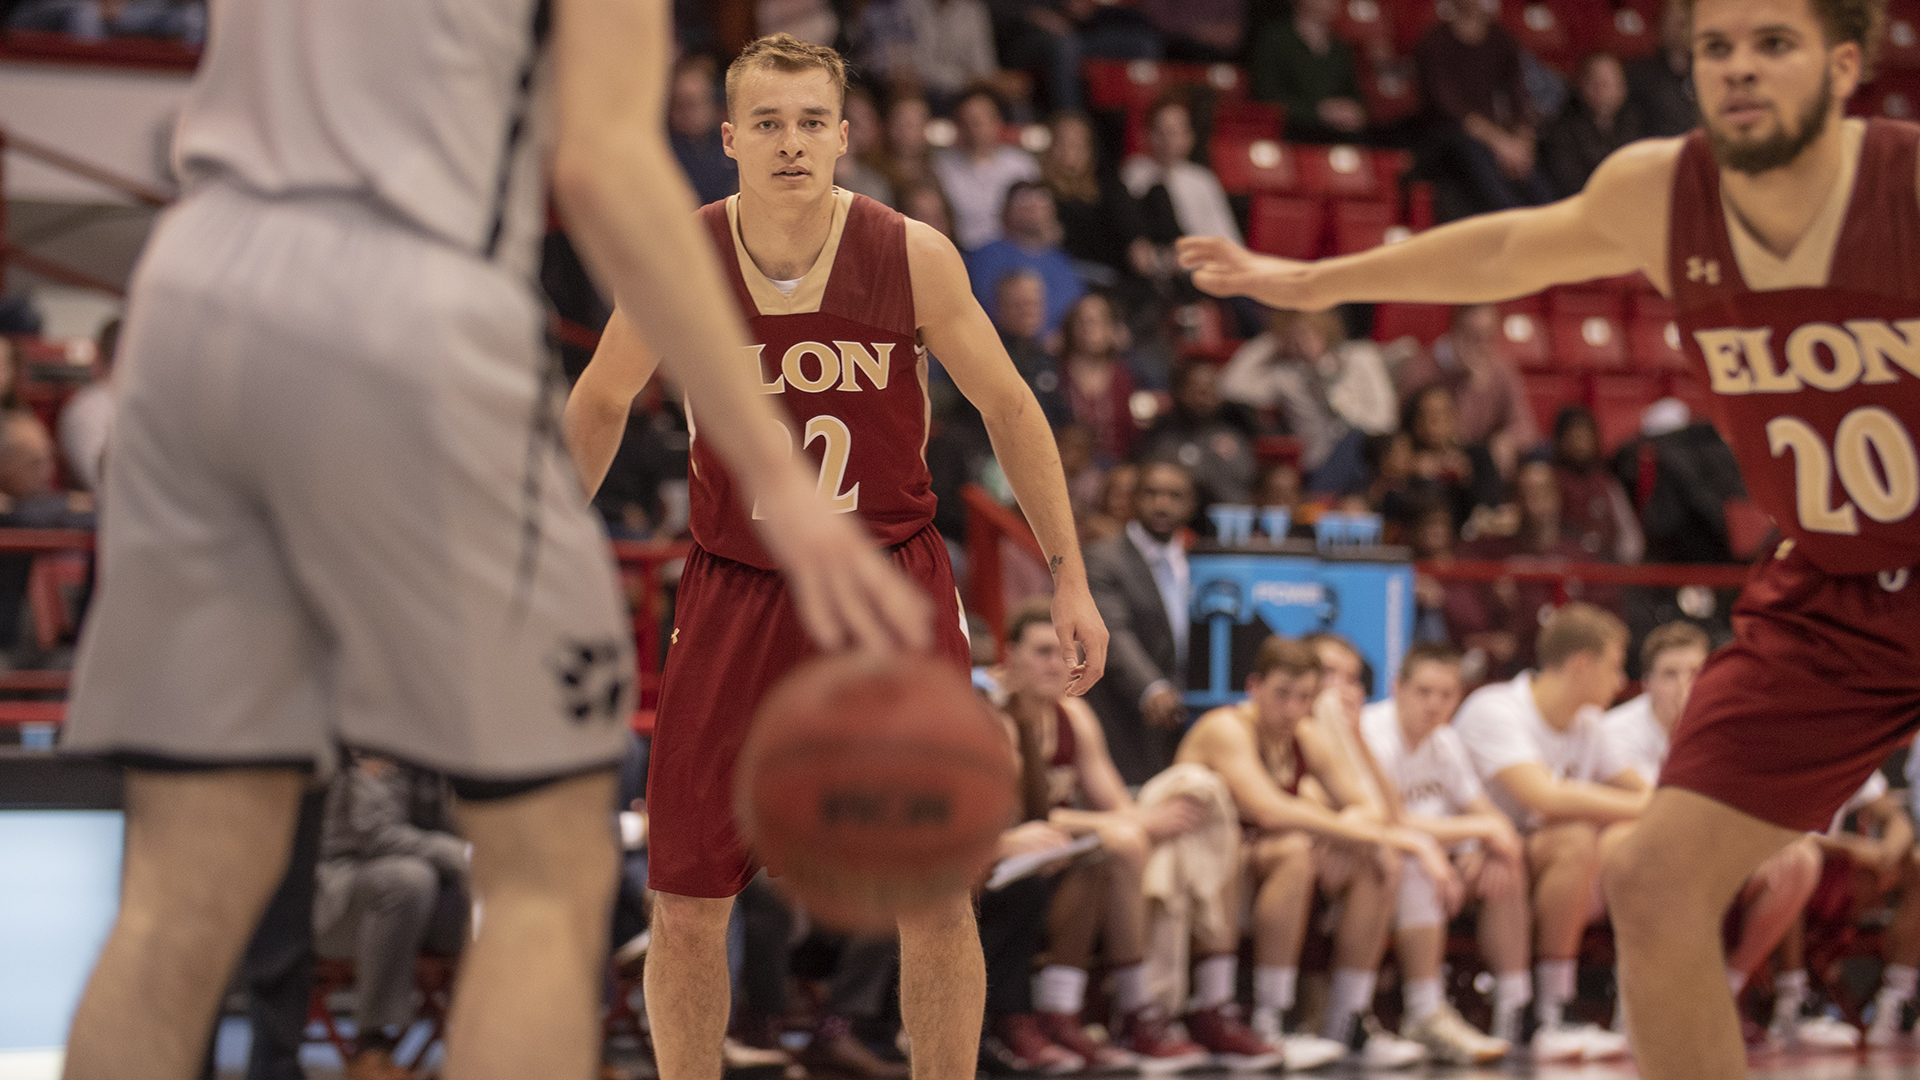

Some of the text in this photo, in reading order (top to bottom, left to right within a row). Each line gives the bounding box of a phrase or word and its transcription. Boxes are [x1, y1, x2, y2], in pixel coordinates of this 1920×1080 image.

[742, 340, 896, 394] LON
[1693, 317, 1920, 395] ELON
[752, 414, 860, 520] 2
[1765, 405, 1920, 536] 20
